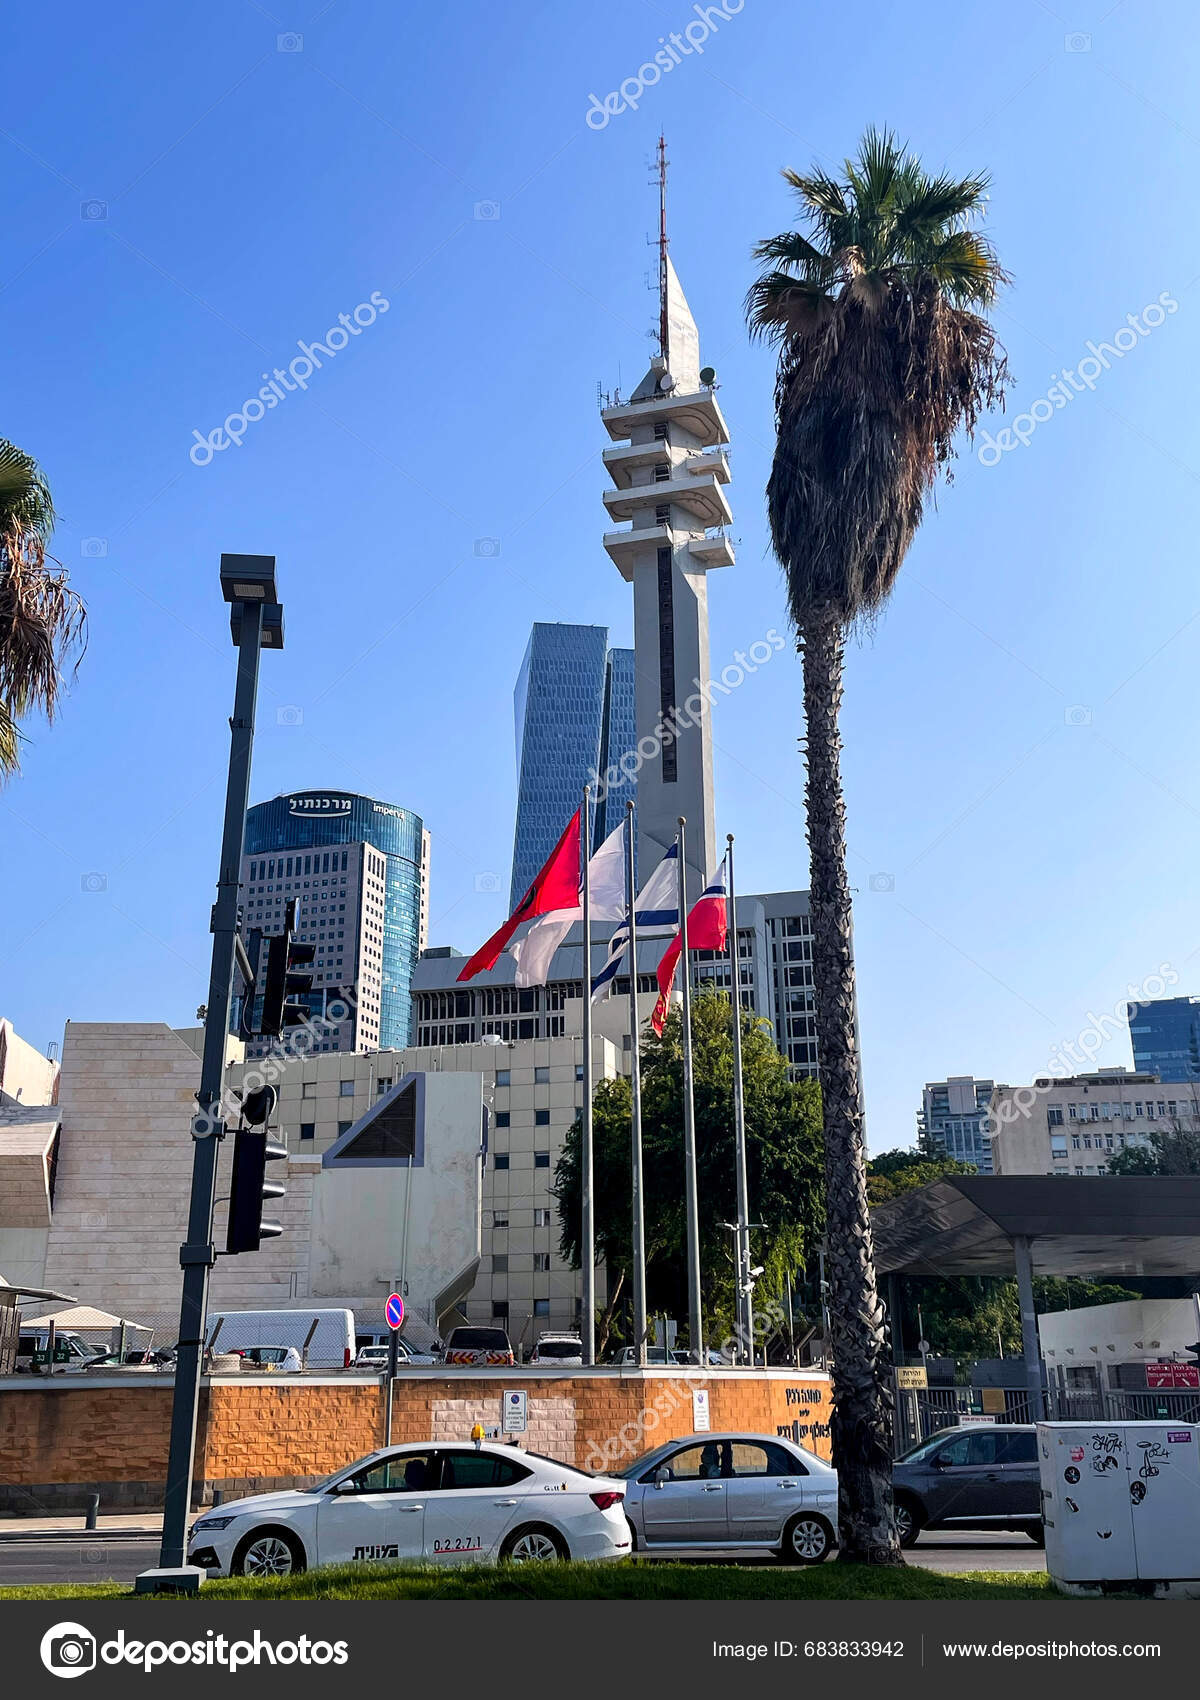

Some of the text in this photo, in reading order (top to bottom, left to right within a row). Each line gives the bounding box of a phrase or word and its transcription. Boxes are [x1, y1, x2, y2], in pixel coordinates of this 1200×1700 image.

[289, 798, 351, 810] מרכנתיל
[785, 1388, 800, 1406] רבין
[352, 1544, 399, 1560] מונית
